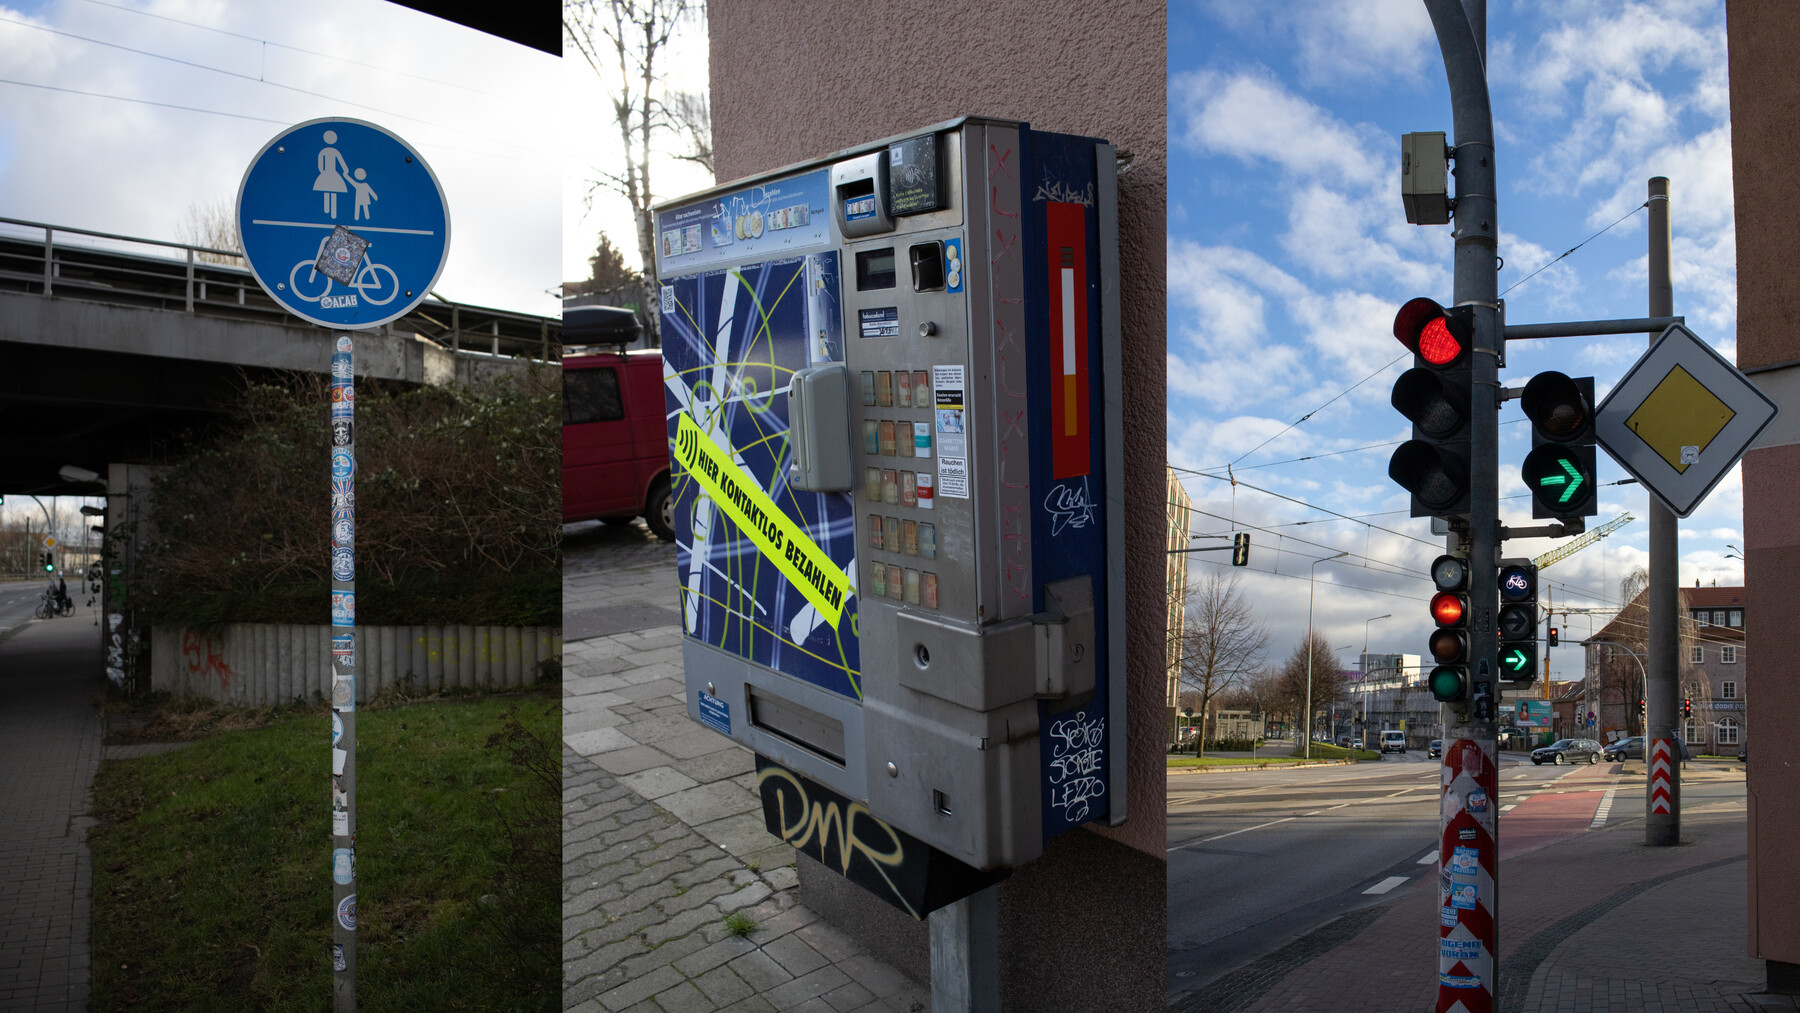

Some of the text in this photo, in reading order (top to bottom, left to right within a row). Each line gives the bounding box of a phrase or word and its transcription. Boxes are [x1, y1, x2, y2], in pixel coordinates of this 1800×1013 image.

[333, 295, 358, 308] ACAB
[941, 458, 963, 466] Rauchen
[698, 448, 842, 612] HIER KONTAKTLOS BEZAHLEN
